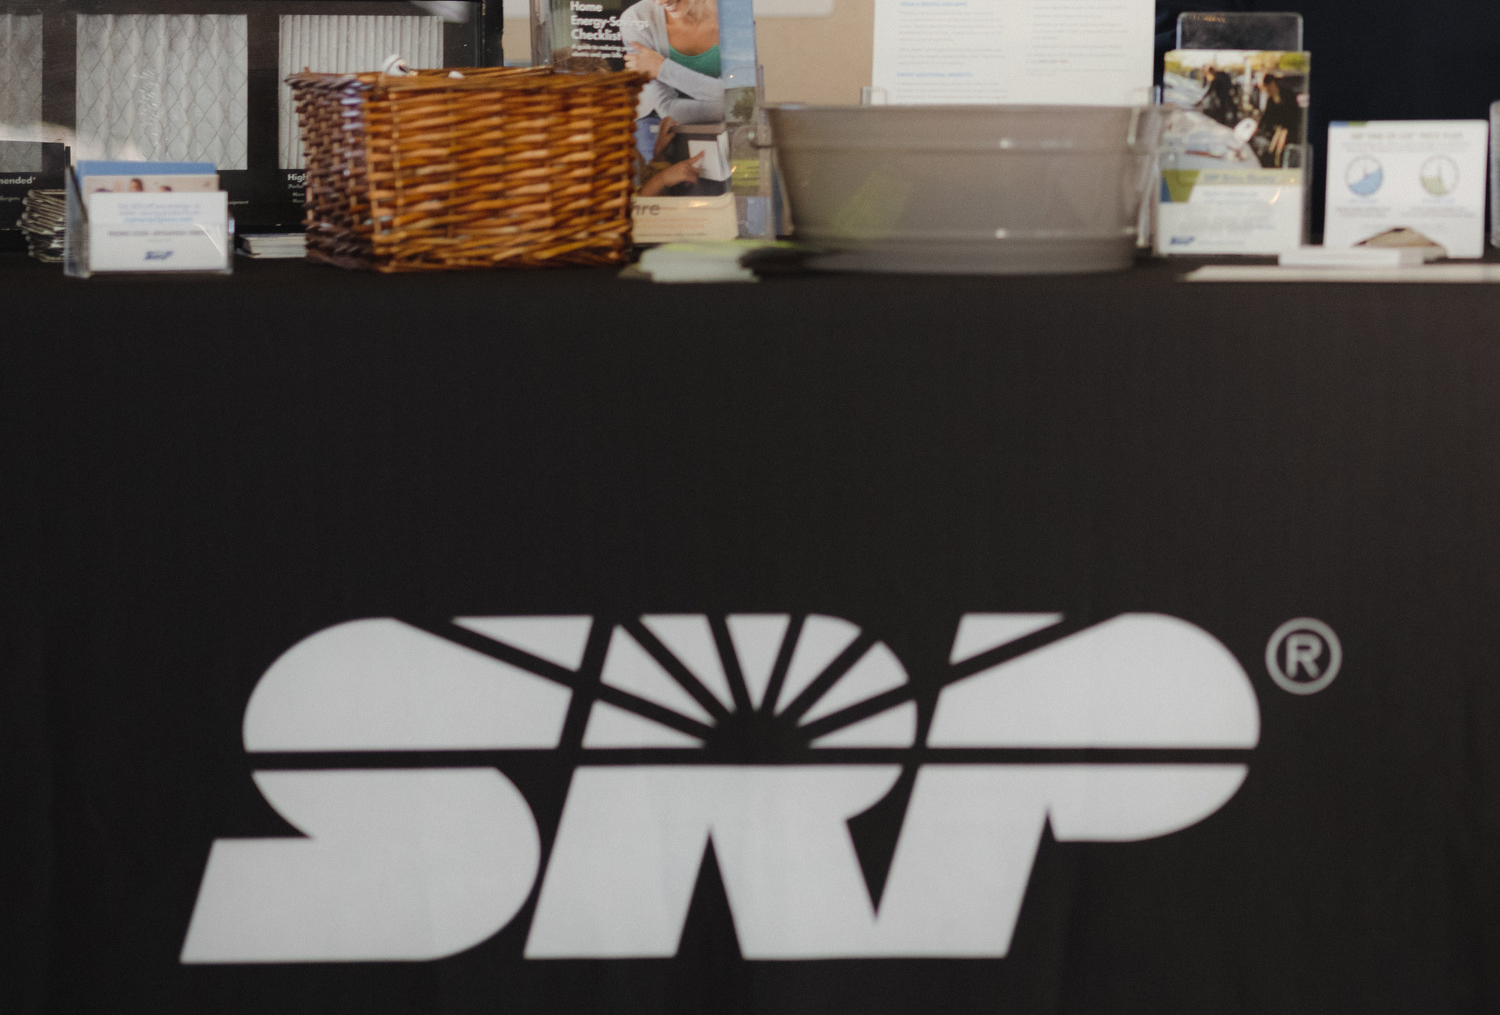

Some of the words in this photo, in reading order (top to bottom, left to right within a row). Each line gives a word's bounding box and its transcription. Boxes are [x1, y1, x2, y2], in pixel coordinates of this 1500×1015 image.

[570, 1, 603, 12] Home
[571, 28, 623, 41] Checklist
[287, 173, 308, 183] High
[179, 612, 1262, 964] SRP
